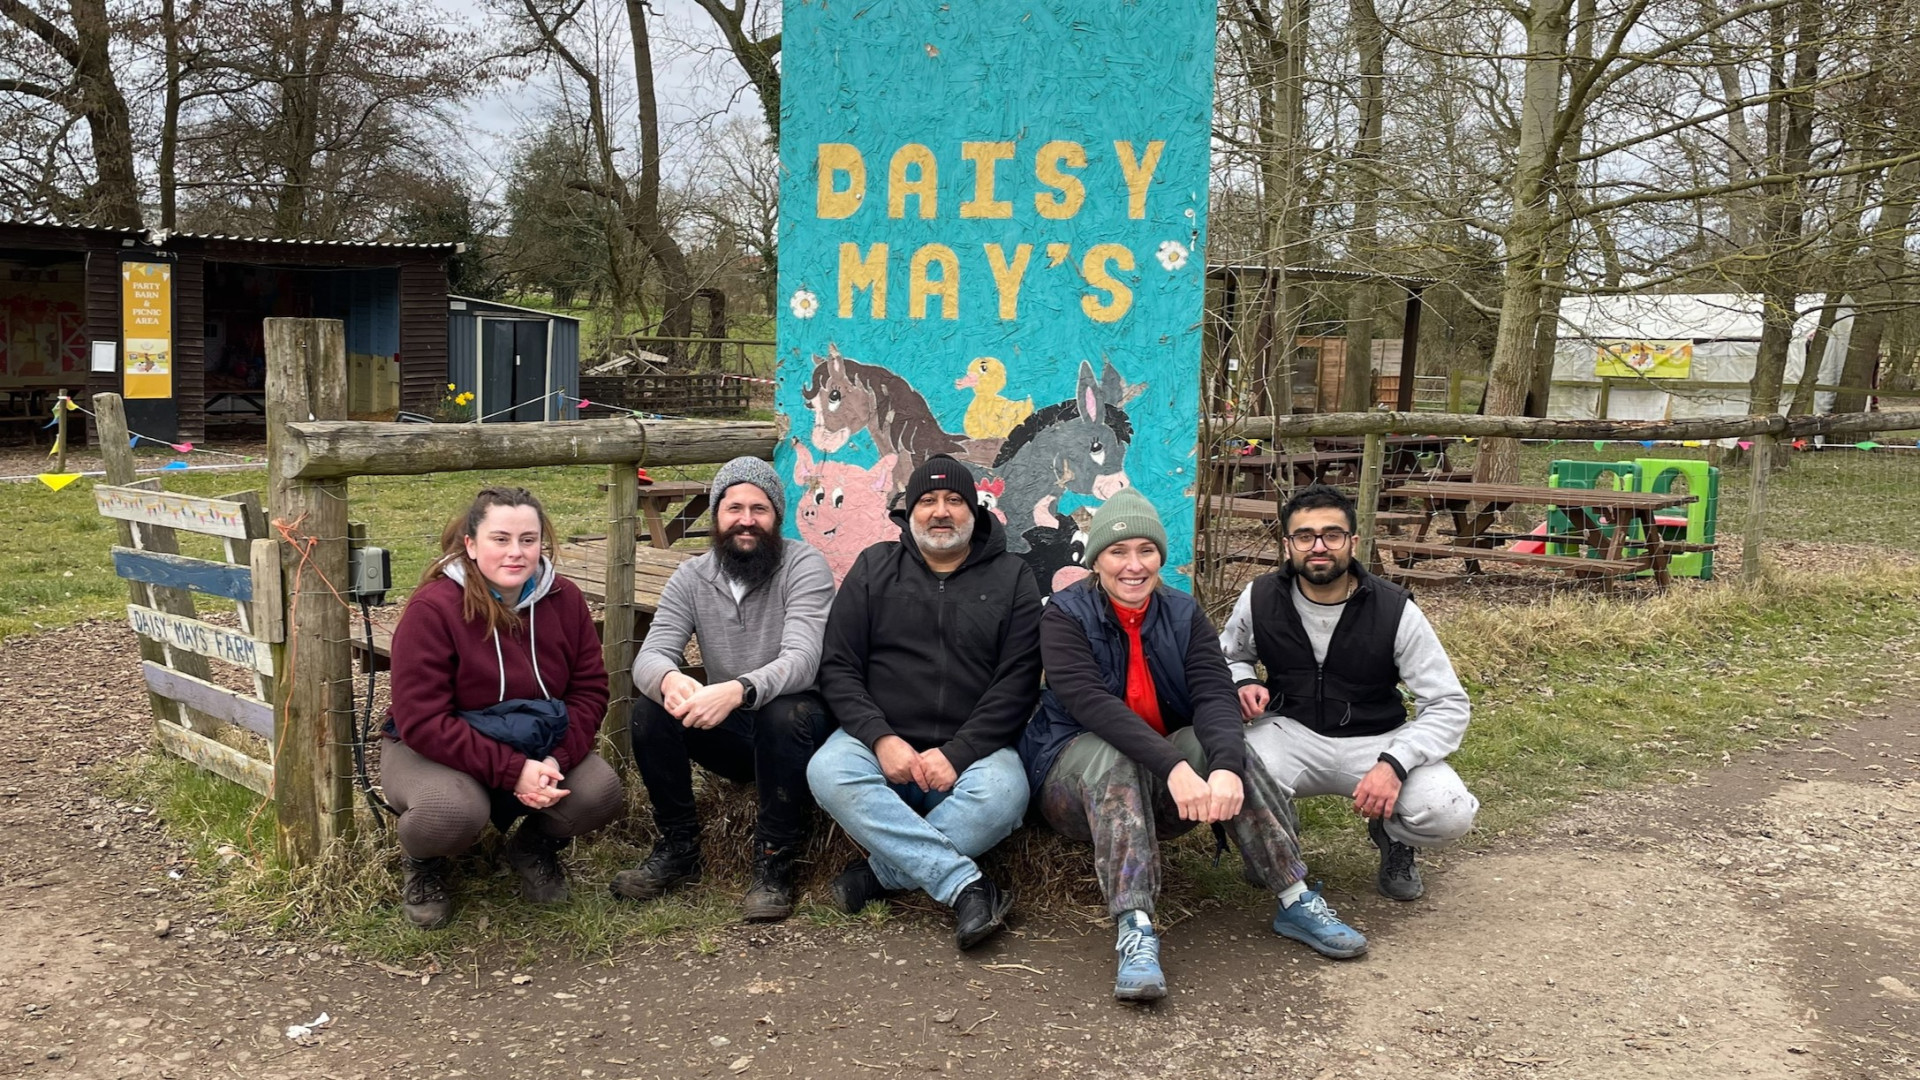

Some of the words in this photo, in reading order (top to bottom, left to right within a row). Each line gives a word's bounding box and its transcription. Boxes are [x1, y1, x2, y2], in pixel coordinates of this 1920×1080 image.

[816, 140, 1166, 220] DAISY
[132, 282, 160, 290] PARTY
[837, 241, 1135, 323] MAY'S
[132, 308, 162, 316] PICNIC
[135, 317, 159, 325] AREA
[134, 610, 168, 638] DAISY
[215, 631, 257, 668] FARM
